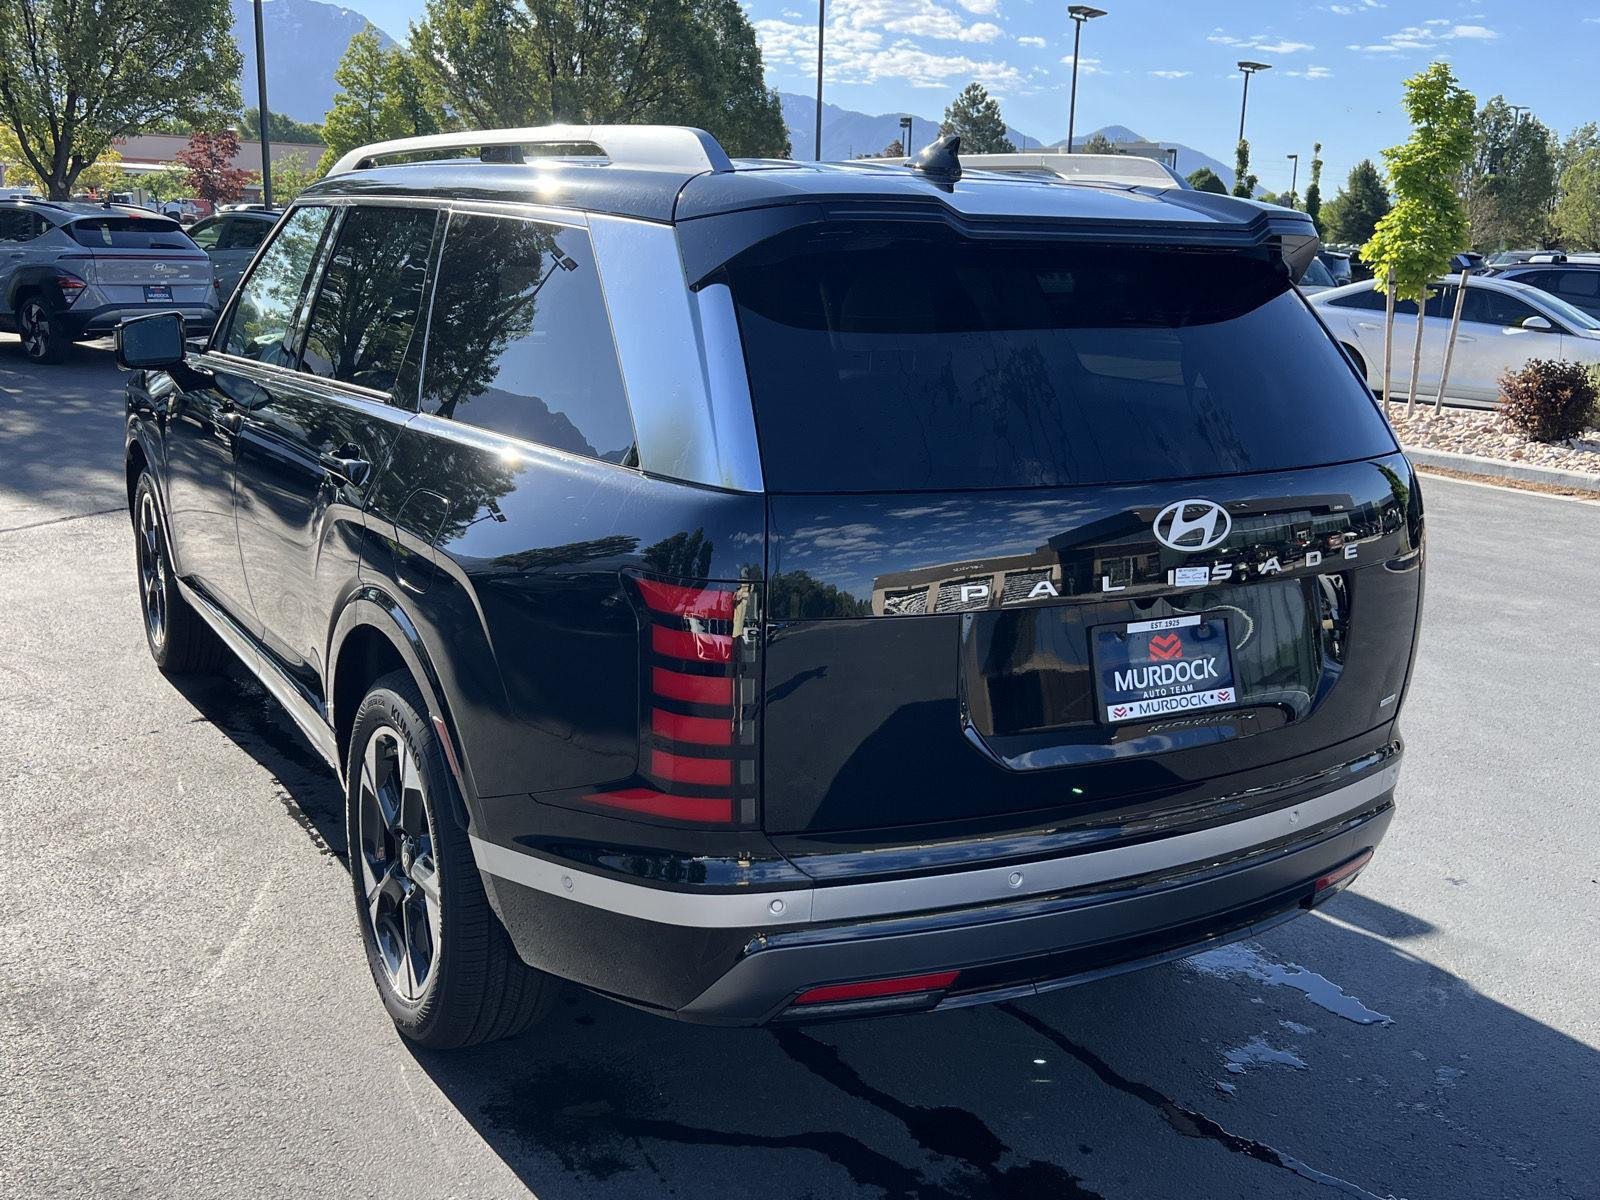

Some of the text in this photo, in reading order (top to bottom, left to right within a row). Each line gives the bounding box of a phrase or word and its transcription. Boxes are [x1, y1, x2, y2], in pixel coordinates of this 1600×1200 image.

[960, 543, 1358, 602] PALISADE
[1164, 619, 1180, 628] 1925
[1114, 657, 1218, 692] MURDOCK
[1143, 684, 1194, 699] AUTO TEAM
[1138, 693, 1208, 715] MURDOCK
